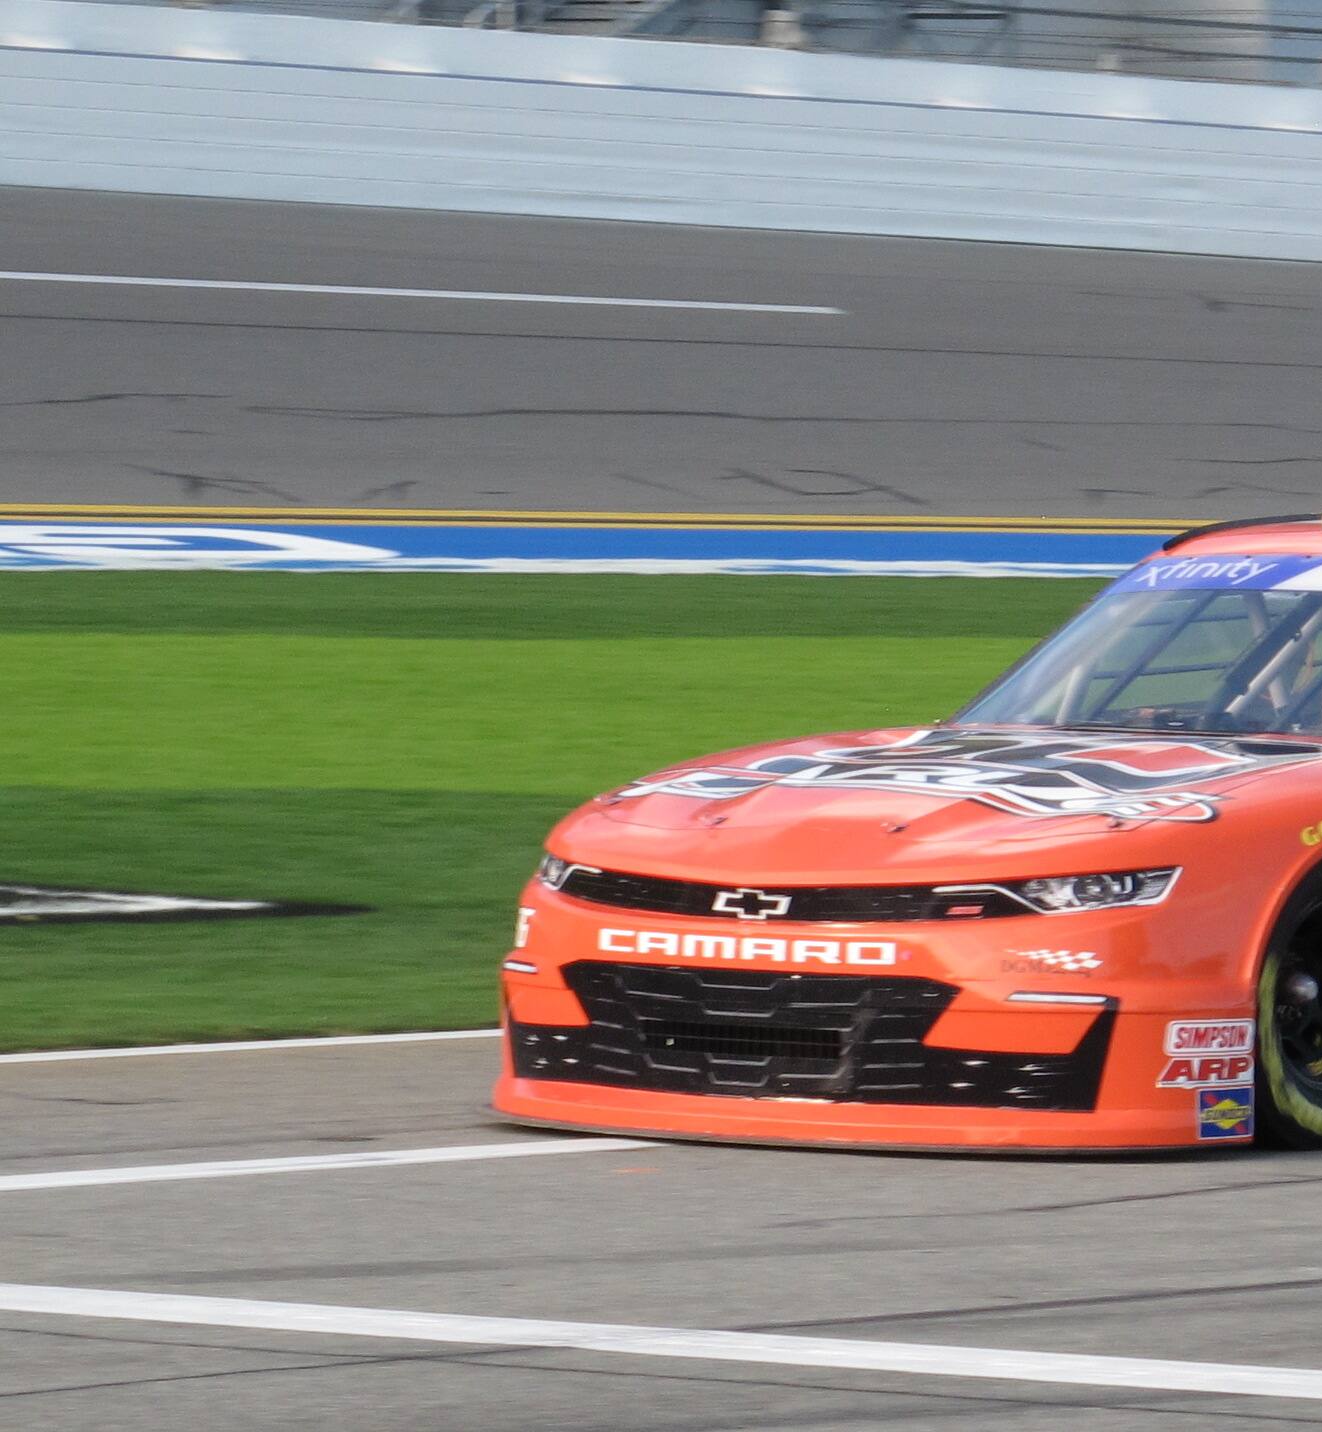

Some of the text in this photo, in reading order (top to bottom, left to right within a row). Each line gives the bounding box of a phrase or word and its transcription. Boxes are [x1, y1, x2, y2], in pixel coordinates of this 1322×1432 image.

[1136, 557, 1279, 587] xfinity
[598, 928, 897, 966] CAMARO
[1173, 1025, 1250, 1049] SIMPSON
[1160, 1056, 1250, 1082] ARP
